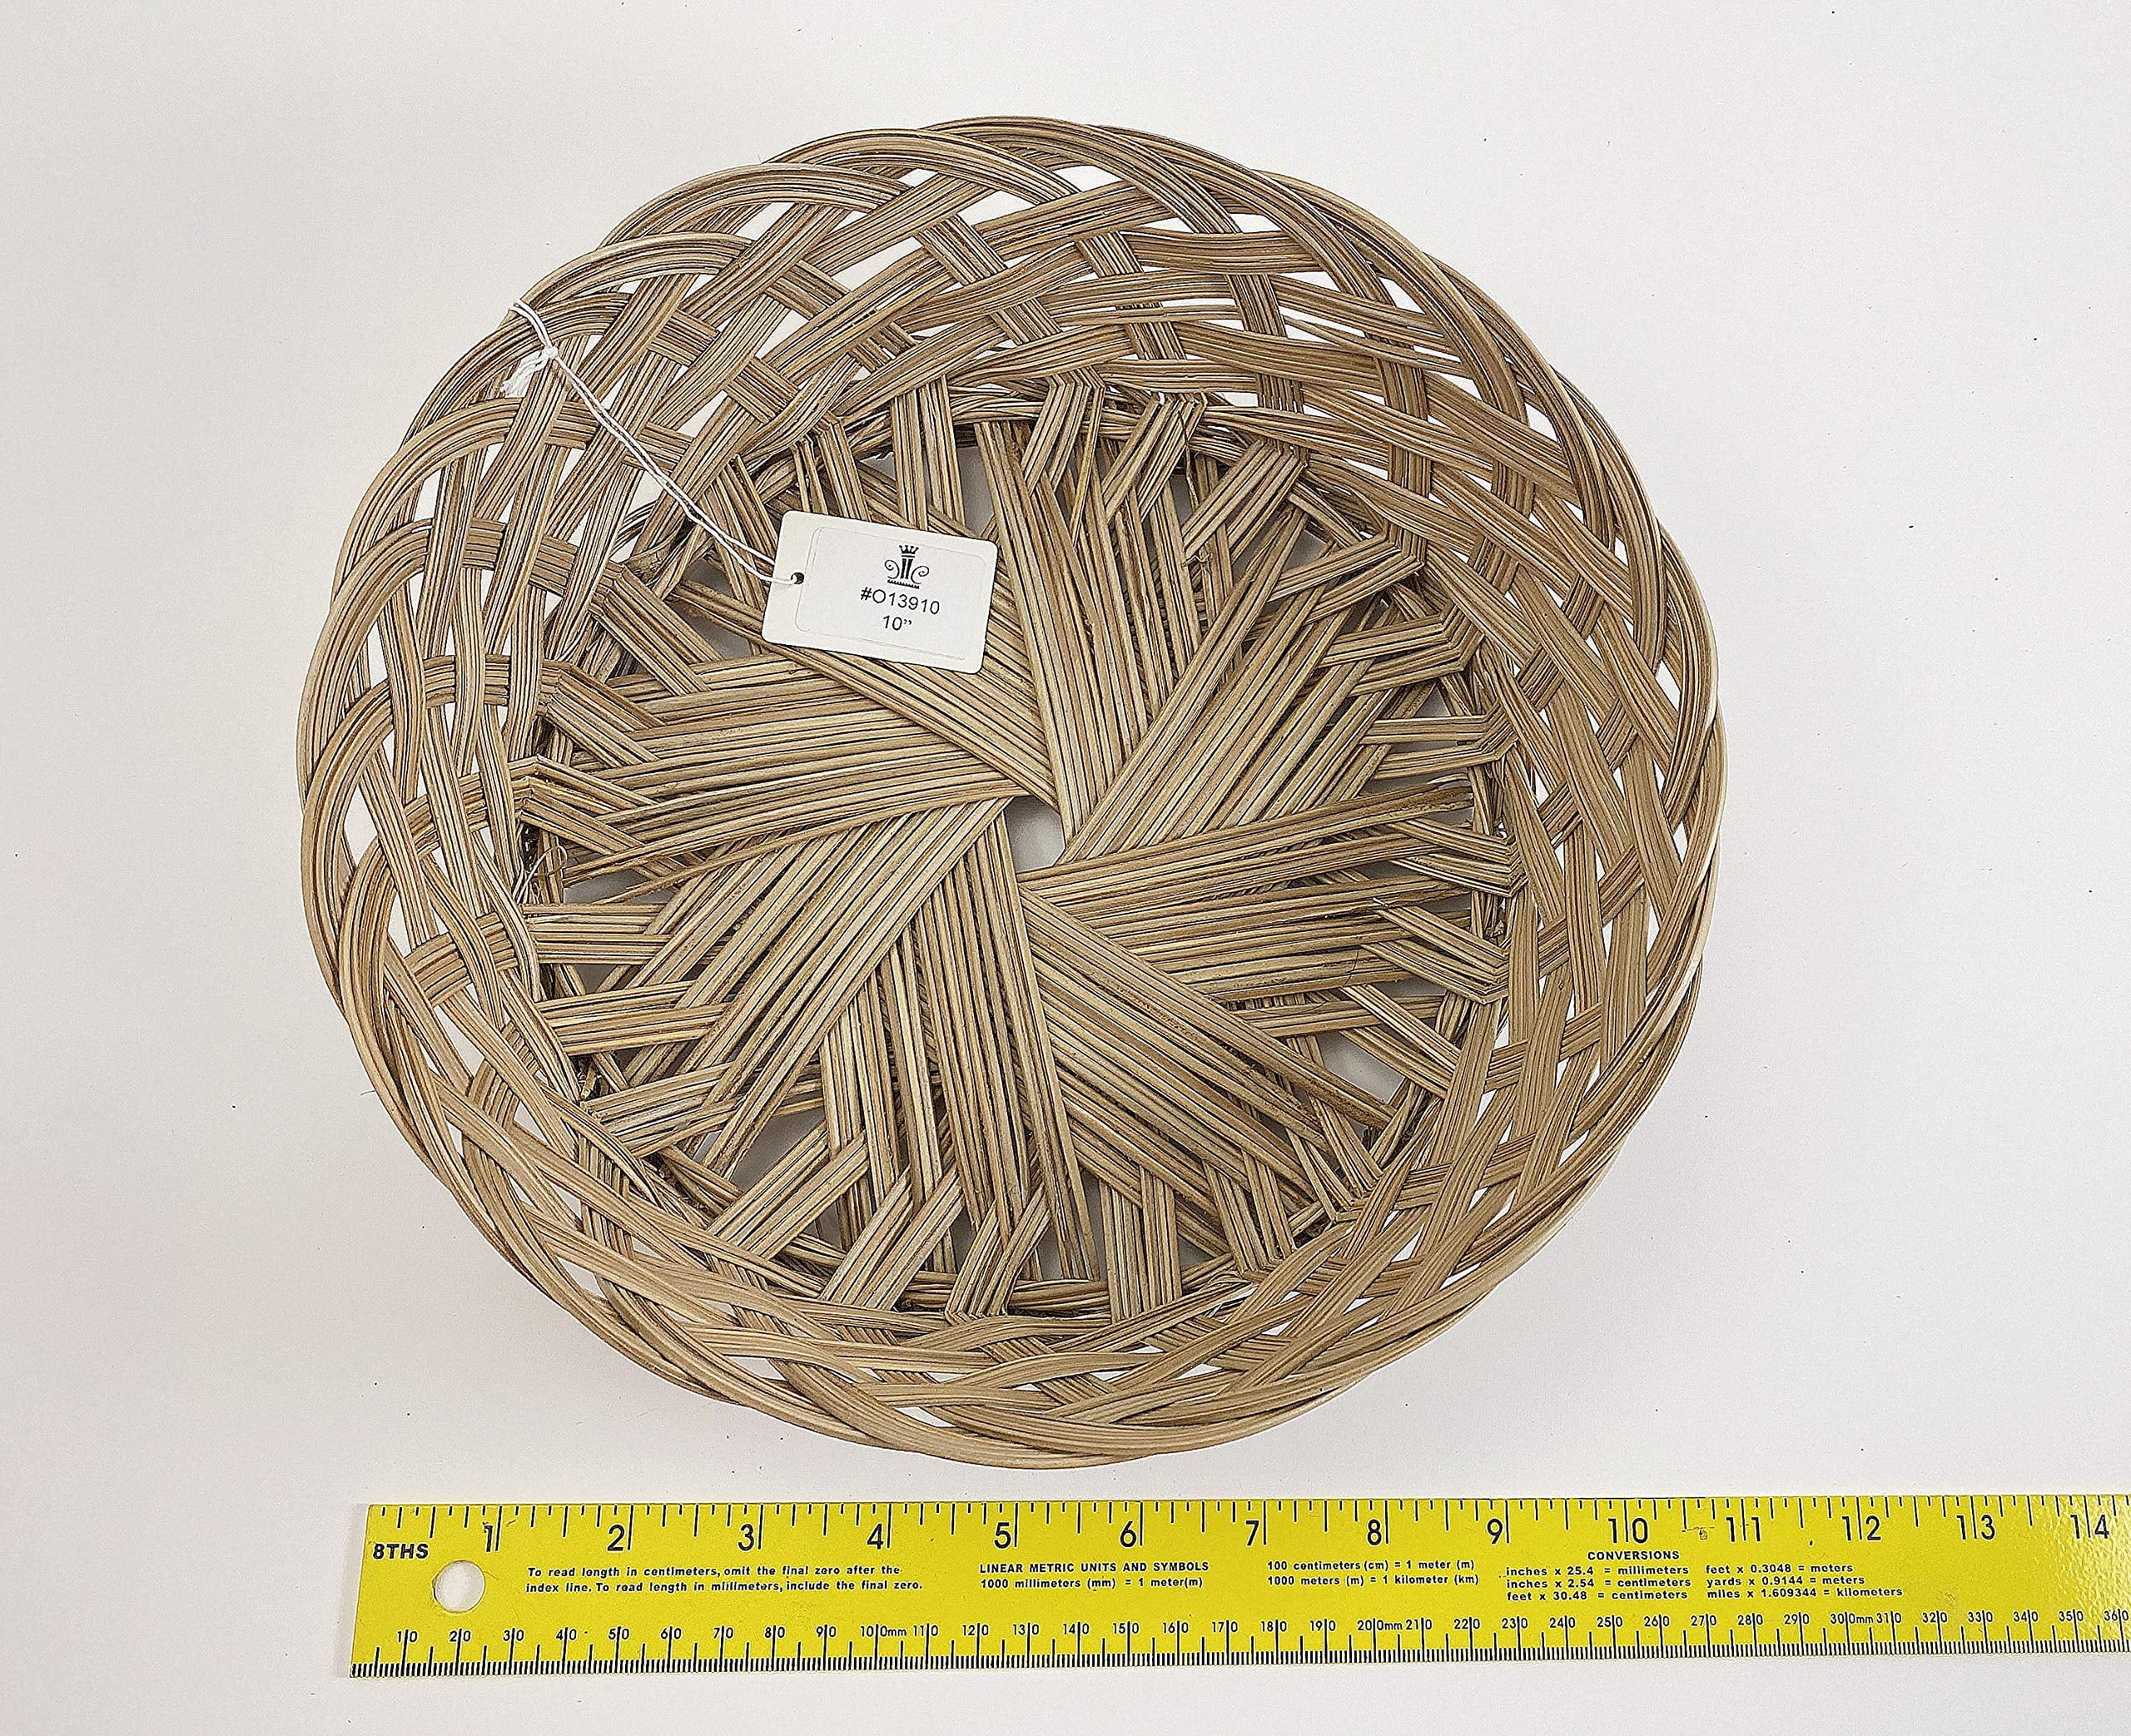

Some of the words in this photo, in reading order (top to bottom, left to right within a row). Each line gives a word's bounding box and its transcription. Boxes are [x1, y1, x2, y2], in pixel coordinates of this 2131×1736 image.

[483, 1524, 494, 1551] 1
[608, 1523, 626, 1550] 2
[738, 1522, 755, 1550] 3
[867, 1522, 884, 1549] 4
[994, 1521, 1011, 1548] 5
[1120, 1520, 1137, 1547] 6
[1245, 1520, 1259, 1546] 7
[1366, 1518, 1383, 1545] 8
[1486, 1517, 1503, 1544] 9
[1607, 1516, 1648, 1543] 10
[1727, 1515, 1761, 1542] 11
[1841, 1515, 1881, 1541] 12
[1956, 1514, 1996, 1540] 13
[2070, 1513, 2109, 1540] 14
[373, 1543, 429, 1560] 8THS
[1588, 1551, 1679, 1560] CONVERSIONS
[981, 1564, 1023, 1573] LINEAR
[1030, 1564, 1074, 1572] METRIC
[1081, 1563, 1115, 1571] UNITS
[1123, 1563, 1146, 1571] AND
[1154, 1562, 1208, 1571] SYMBOLS
[1268, 1561, 1287, 1570] 100
[1294, 1561, 1360, 1570] centimeters
[1364, 1560, 1388, 1571] (cm)
[1407, 1560, 1411, 1569] 1
[1418, 1560, 1450, 1569] meter
[1457, 1560, 1473, 1570] (m)
[1507, 1567, 1547, 1575] inches
[1567, 1566, 1593, 1575] 25.4
[1618, 1565, 1688, 1575] millimeters
[1706, 1565, 1730, 1574] feet
[1751, 1564, 1791, 1573] 0.3048
[1811, 1564, 1852, 1572] meters
[529, 1568, 541, 1576] To
[549, 1568, 574, 1576] read
[583, 1567, 619, 1579] length
[627, 1567, 637, 1575] in
[644, 1567, 720, 1577] centimeters,
[724, 1566, 749, 1575] omit
[758, 1566, 775, 1575] the
[782, 1566, 808, 1575] final
[847, 1565, 875, 1574] after
[882, 1565, 899, 1574] the
[981, 1579, 1008, 1588] 1000
[1016, 1579, 1080, 1588] millimeters
[1088, 1578, 1115, 1589] (mm)
[1139, 1578, 1143, 1586] 1
[1151, 1577, 1202, 1588] meter(m)
[1269, 1576, 1294, 1585] 1000
[1347, 1575, 1364, 1586] (m)
[1383, 1575, 1387, 1584] 1
[1395, 1575, 1448, 1584] kilometer
[1454, 1575, 1478, 1585] (km)
[1508, 1580, 1547, 1588] inches
[1568, 1579, 1594, 1587] 2.54
[1617, 1578, 1691, 1587] centimeters
[1706, 1577, 1741, 1588] yards
[1762, 1576, 1802, 1585] 0.9144
[526, 1584, 559, 1592] index
[566, 1583, 591, 1591] line.
[596, 1583, 609, 1591] To
[616, 1583, 643, 1591] read
[650, 1582, 686, 1593] length
[694, 1582, 704, 1590] in
[712, 1582, 782, 1592] millimeters,
[787, 1581, 829, 1590] include
[837, 1581, 854, 1590] the
[862, 1580, 887, 1589] final
[1508, 1592, 1532, 1600] feet
[1553, 1591, 1587, 1600] 30.48
[1612, 1590, 1687, 1599] centimeters
[1707, 1590, 1740, 1598] miles
[1761, 1589, 1816, 1597] 1.609344
[1837, 1588, 1902, 1596] kilometers
[396, 1629, 417, 1642] 10
[450, 1629, 471, 1641] 20
[503, 1628, 524, 1640] 30
[556, 1628, 577, 1640] 40
[609, 1627, 629, 1639] 50
[661, 1626, 682, 1639] 60
[713, 1625, 733, 1638] 70
[764, 1624, 785, 1637] 80
[816, 1625, 836, 1637] 90
[913, 1624, 938, 1636] 110
[961, 1623, 989, 1635] 120
[1012, 1622, 1039, 1634] 130
[1062, 1622, 1090, 1634] 140
[1112, 1621, 1140, 1633] 150
[1162, 1620, 1189, 1632] 160
[1212, 1619, 1238, 1632] 170
[1260, 1619, 1287, 1631] 180
[1309, 1619, 1336, 1631] 190
[1406, 1618, 1432, 1630] 210
[1454, 1618, 1480, 1629] 220
[1502, 1617, 1528, 1629] 230
[1549, 1616, 1576, 1628] 240
[1597, 1615, 1622, 1627] 250
[1643, 1614, 1670, 1626] 260
[1691, 1614, 1716, 1625] 270
[1738, 1614, 1763, 1625] 280
[1784, 1613, 1810, 1624] 290
[1876, 1612, 1901, 1624] 310
[1922, 1611, 1947, 1623] 320
[1968, 1610, 1993, 1622] 330
[2013, 1610, 2038, 1622] 340
[2059, 1610, 2084, 1621] 350
[2104, 1609, 2129, 1620] 360
